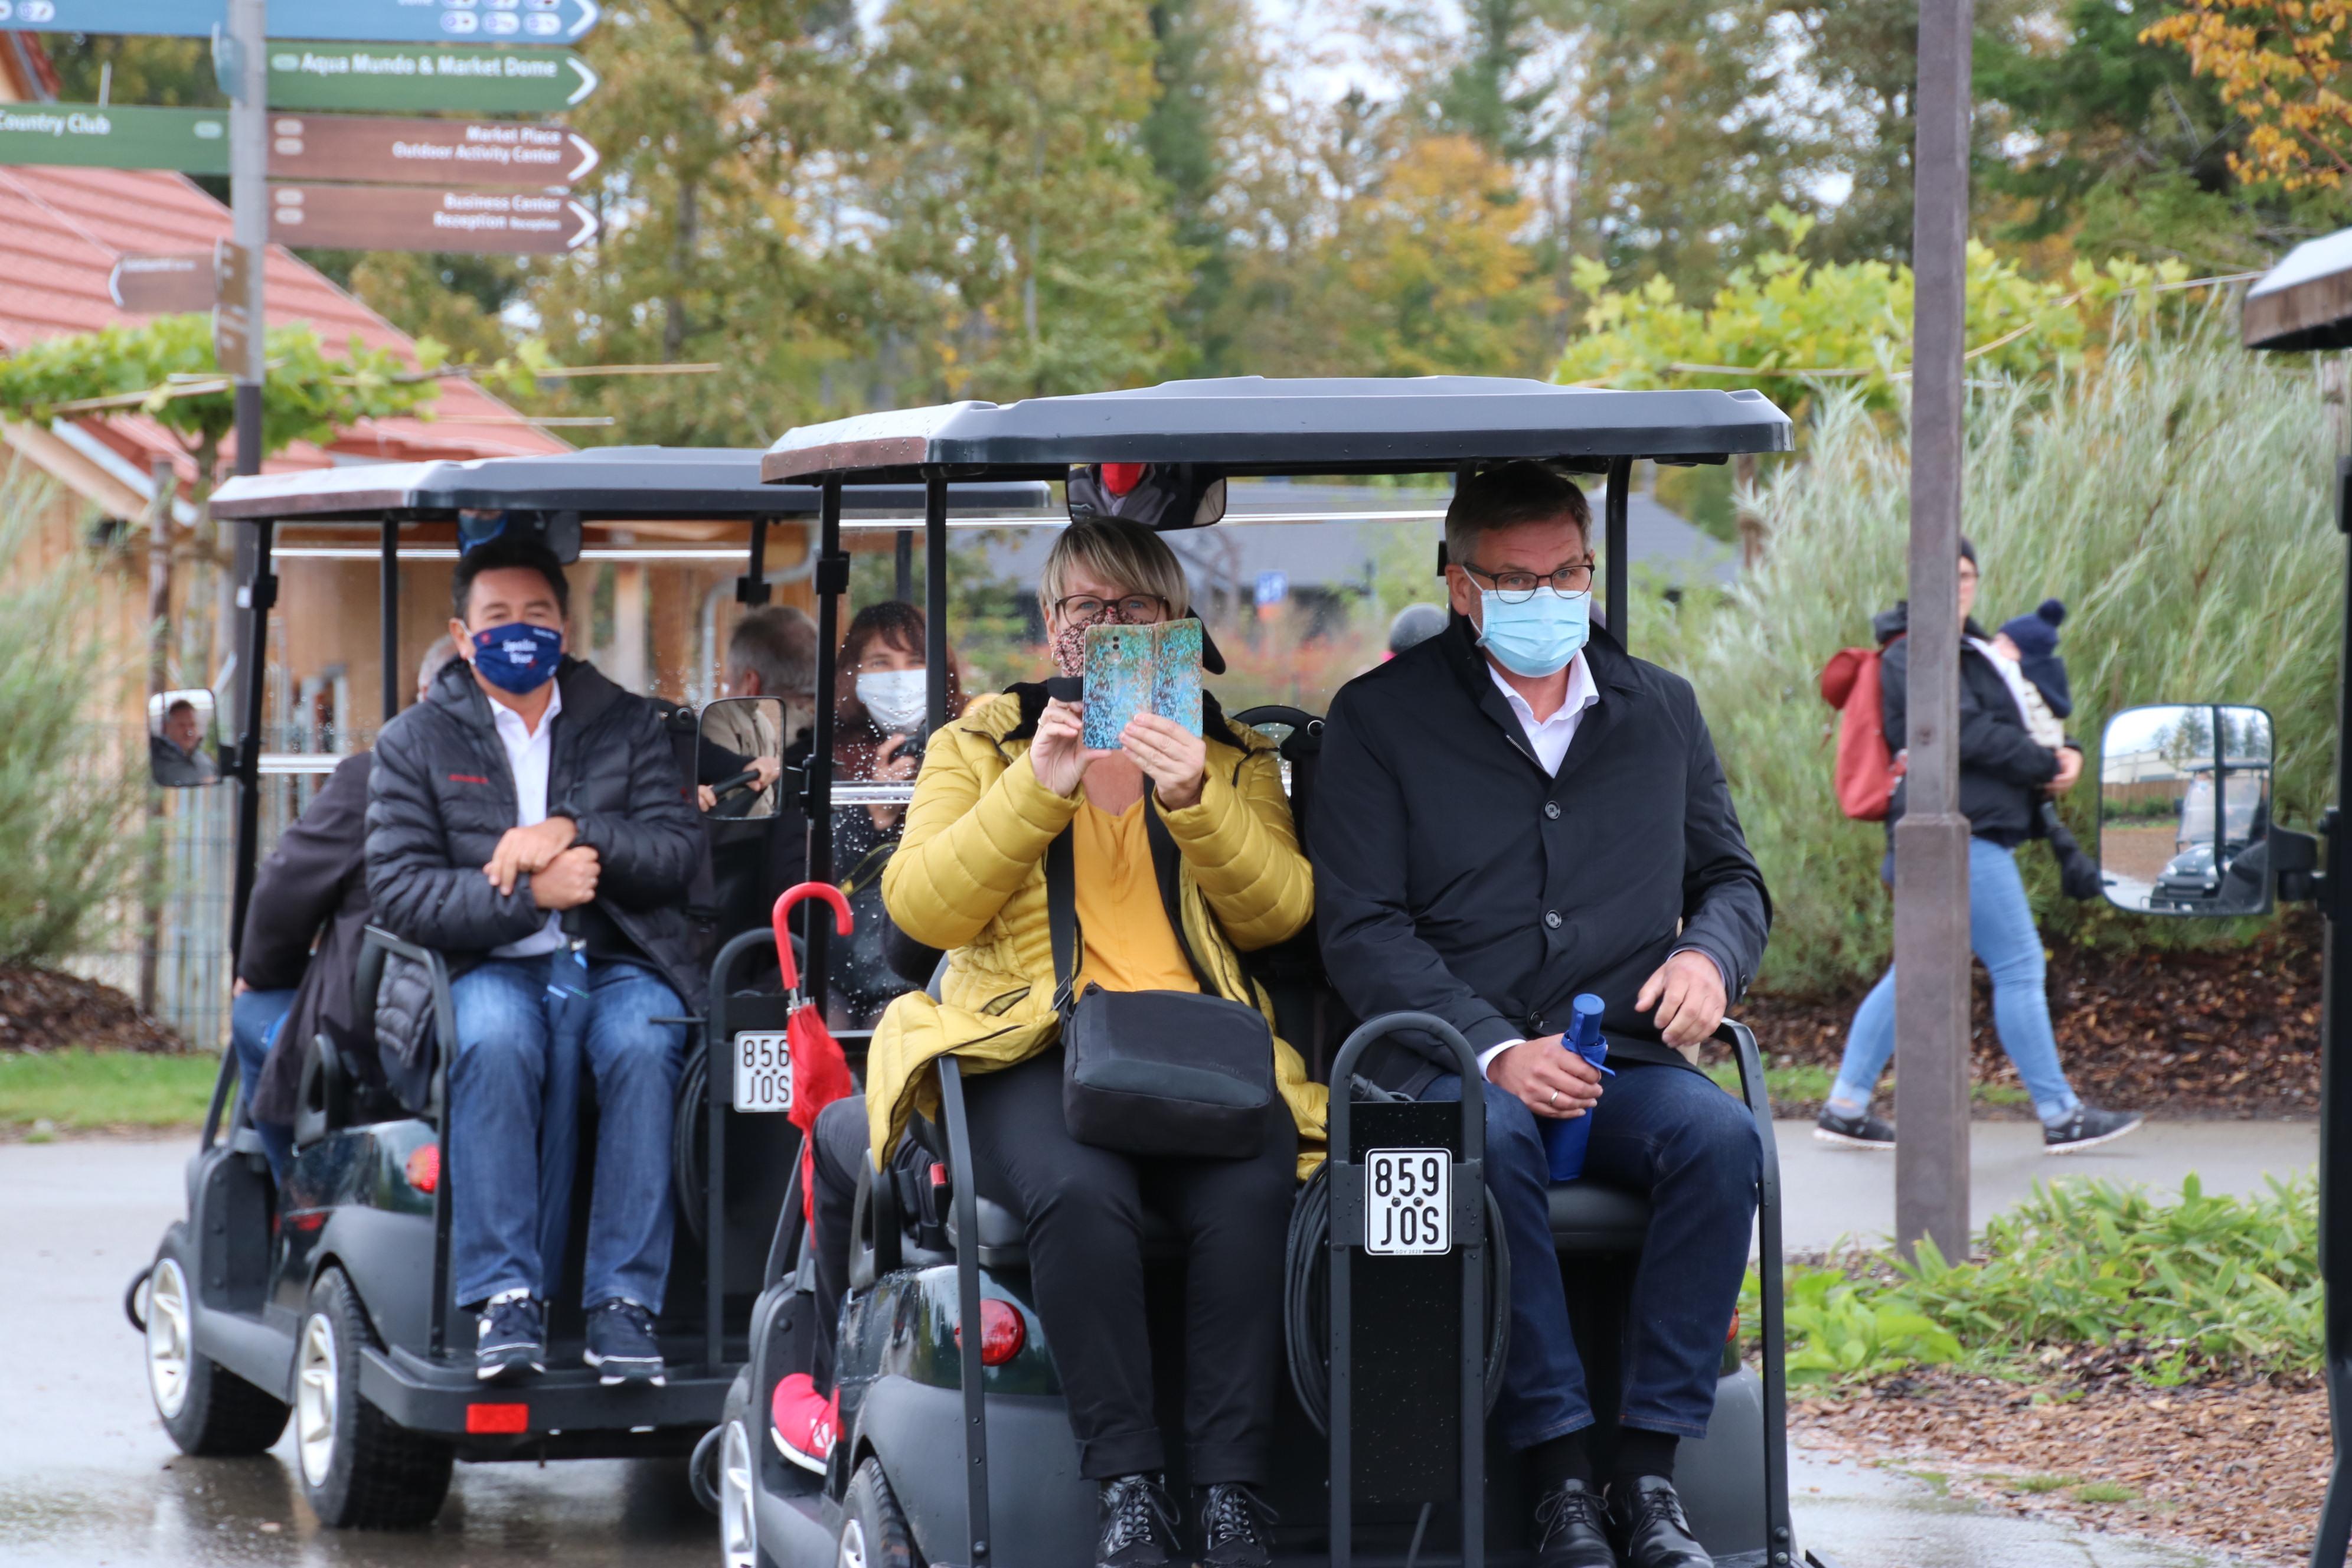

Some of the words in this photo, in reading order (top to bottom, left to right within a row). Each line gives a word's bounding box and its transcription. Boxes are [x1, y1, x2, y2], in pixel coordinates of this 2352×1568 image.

[302, 53, 348, 76] Aqua
[352, 54, 414, 74] Mundo
[419, 55, 434, 76] &
[437, 55, 501, 76] Market
[504, 57, 558, 77] Dome
[67, 113, 111, 135] Club
[466, 126, 518, 143] Market
[520, 127, 561, 145] Place
[393, 141, 453, 160] Outdoor
[455, 144, 510, 165] Activity
[512, 146, 561, 164] Center
[444, 192, 510, 211] Business
[512, 195, 561, 212] Center
[744, 1039, 789, 1067] 856
[746, 1075, 789, 1103] JOS
[1375, 1157, 1439, 1197] 859
[1381, 1206, 1439, 1246] JOS
